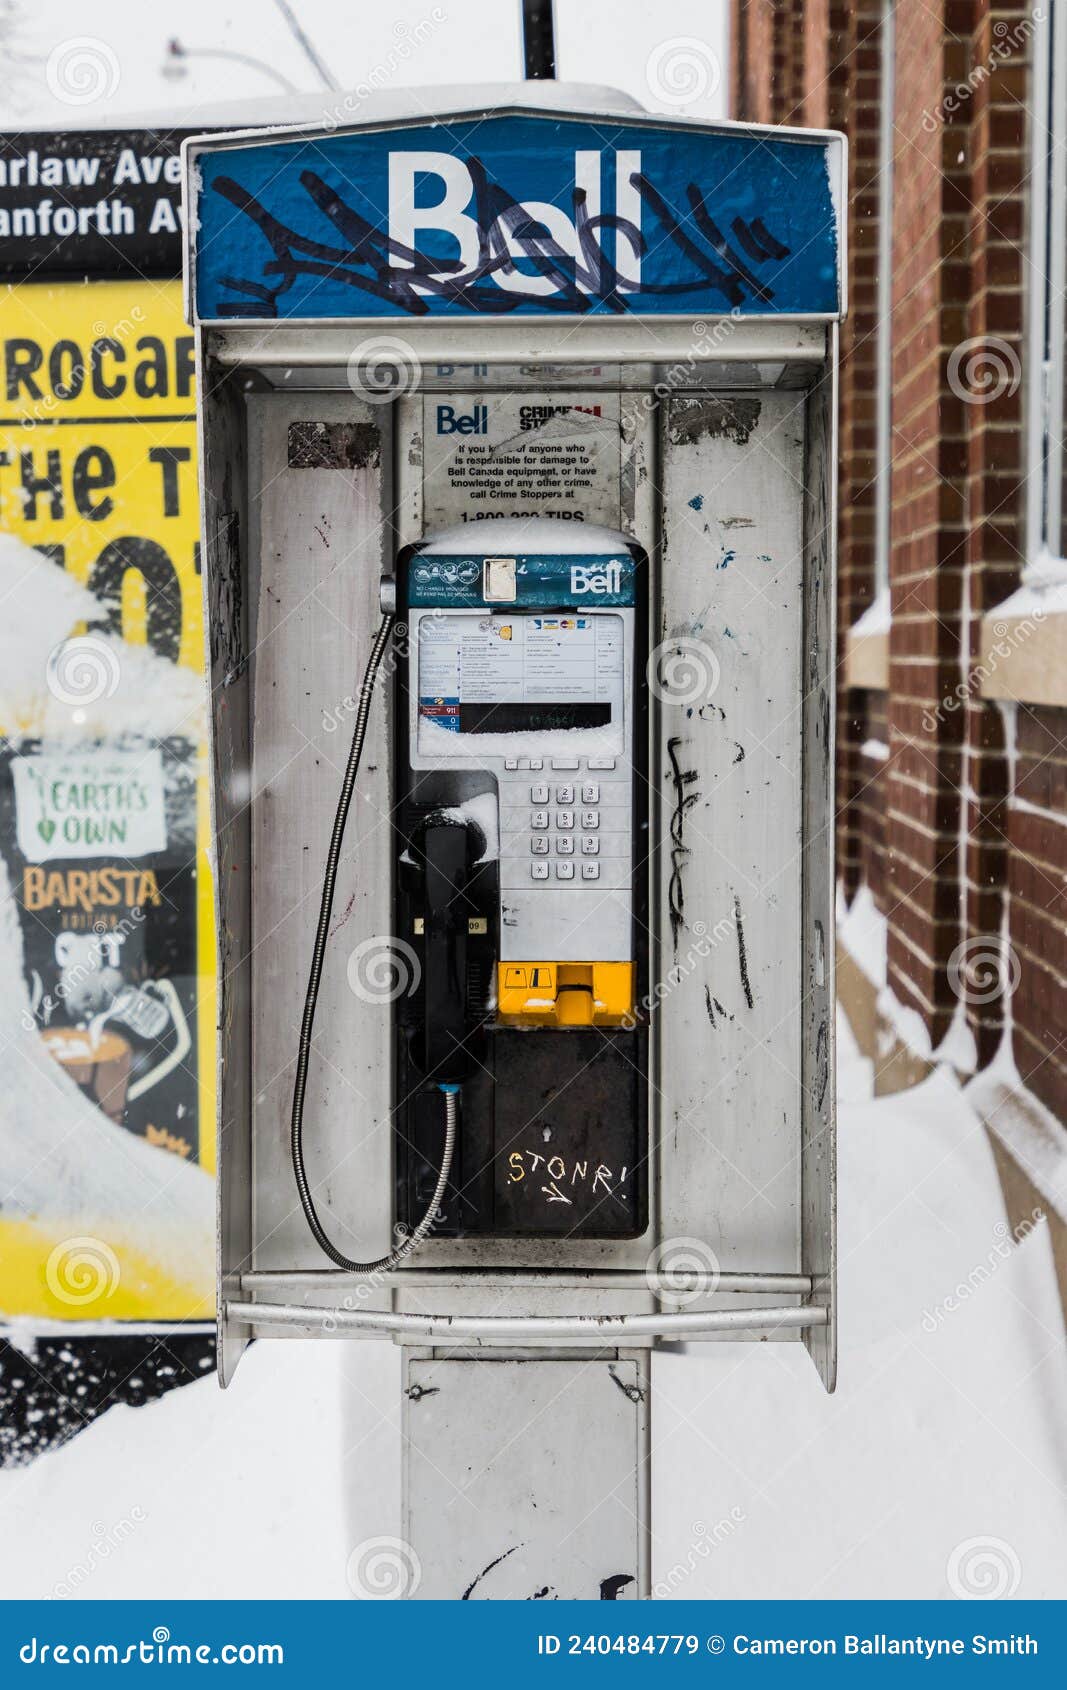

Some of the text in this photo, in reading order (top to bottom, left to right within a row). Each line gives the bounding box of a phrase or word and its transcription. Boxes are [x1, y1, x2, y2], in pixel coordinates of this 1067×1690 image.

[388, 150, 641, 297] Bell
[437, 405, 488, 435] Bell
[458, 444, 466, 453] If
[468, 446, 486, 455] you
[529, 445, 563, 455] anyone
[565, 443, 586, 453] who
[455, 456, 463, 465] is
[524, 456, 537, 465] for
[540, 456, 577, 466] damage
[580, 456, 590, 464] to
[448, 467, 466, 476] Bell
[468, 467, 504, 476] Canada
[574, 467, 597, 475] have
[451, 479, 502, 489] knowledge
[504, 479, 514, 487] of
[536, 479, 561, 487] other
[563, 479, 593, 487] crime,
[470, 490, 575, 499] call Crime Stoppers at
[570, 561, 621, 594] Bell
[446, 707, 456, 715] 911
[62, 816, 127, 845] OWN
[23, 866, 161, 912] BARISTA
